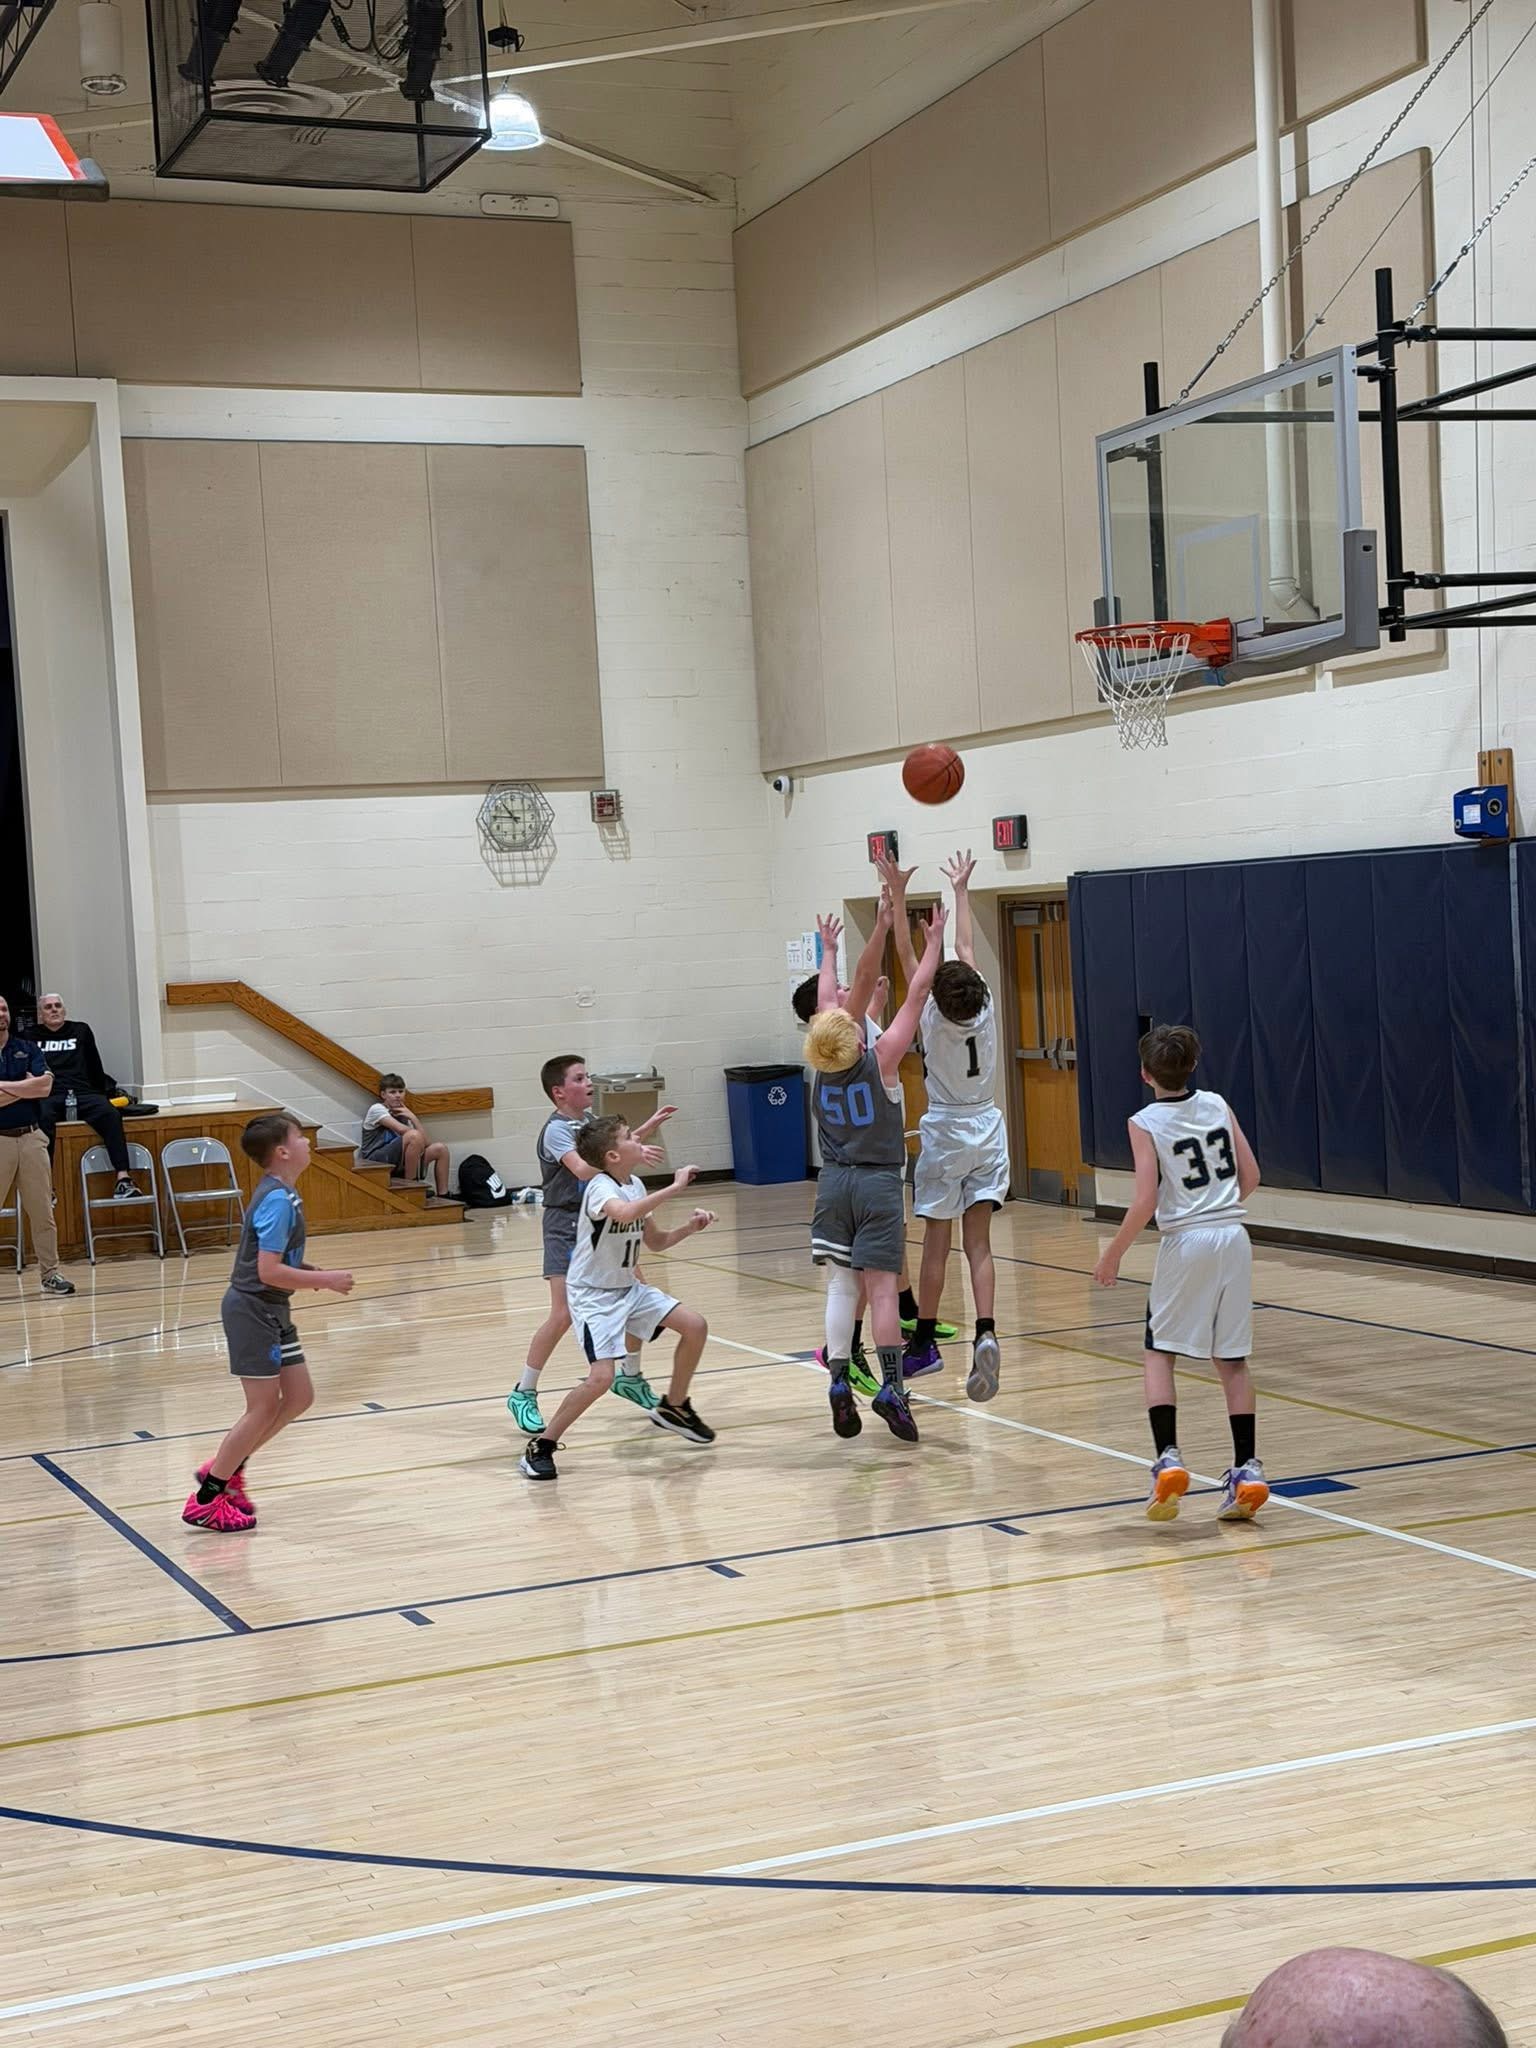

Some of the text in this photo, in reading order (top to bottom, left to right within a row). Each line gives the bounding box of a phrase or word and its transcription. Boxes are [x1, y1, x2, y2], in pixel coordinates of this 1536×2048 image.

[996, 820, 1013, 847] EXIT
[37, 1038, 77, 1052] LIONS
[965, 1036, 980, 1078] 1
[820, 1081, 875, 1127] 50
[1172, 1127, 1236, 1190] 33
